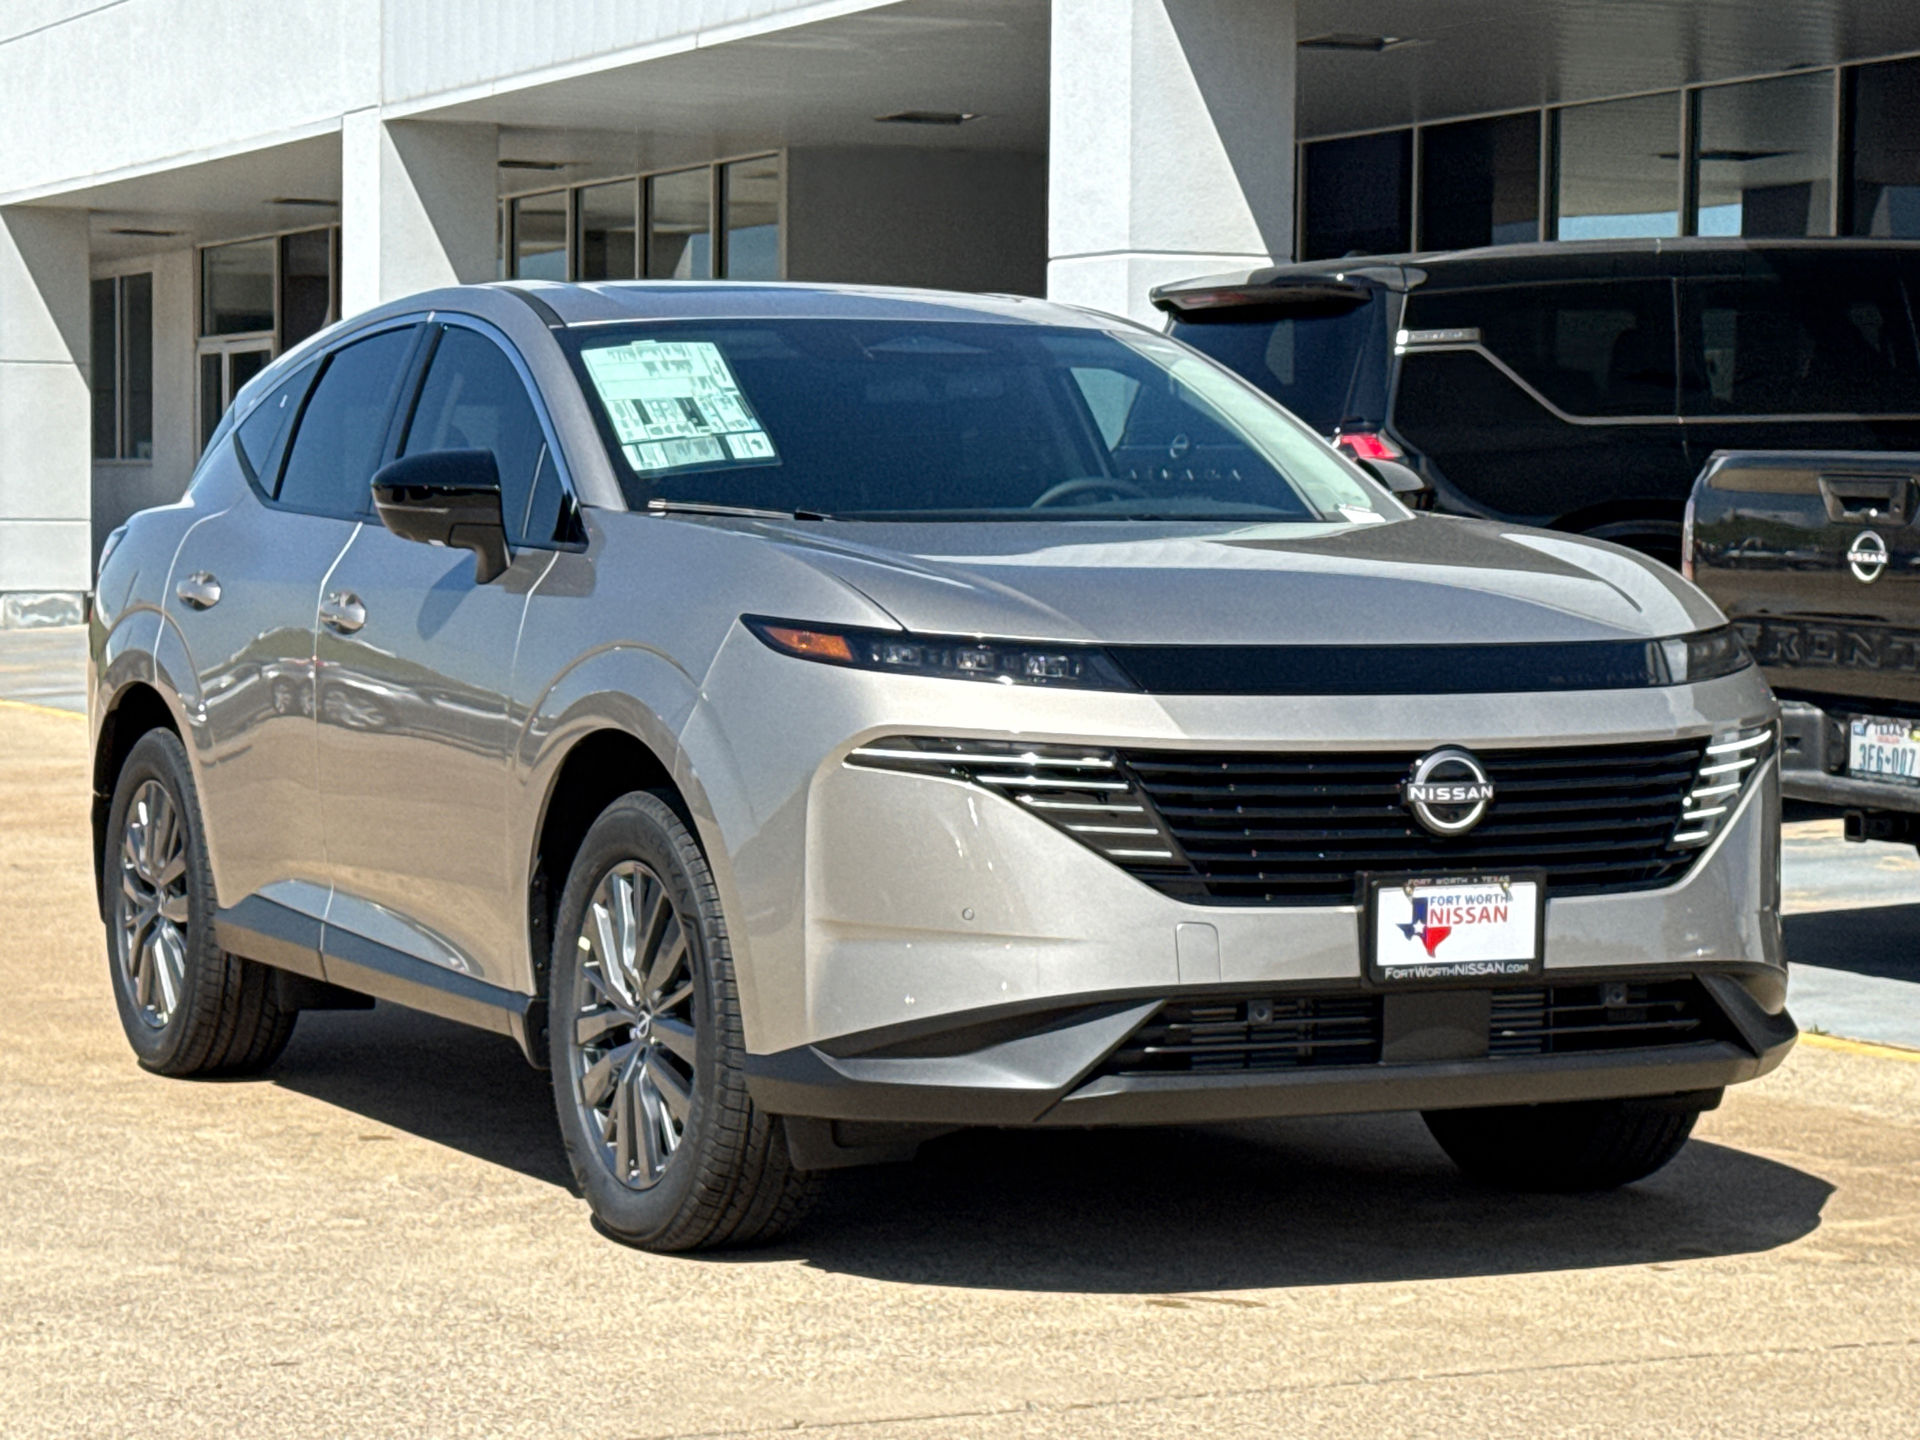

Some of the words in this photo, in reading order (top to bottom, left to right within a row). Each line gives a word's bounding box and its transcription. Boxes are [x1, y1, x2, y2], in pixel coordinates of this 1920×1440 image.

[1409, 785, 1494, 801] NISSAN
[1436, 876, 1468, 885] WORTH
[1481, 874, 1511, 884] TEXAS
[1430, 896, 1461, 906] FORT
[1465, 893, 1508, 905] WORTH
[1430, 905, 1508, 926] NISSAN
